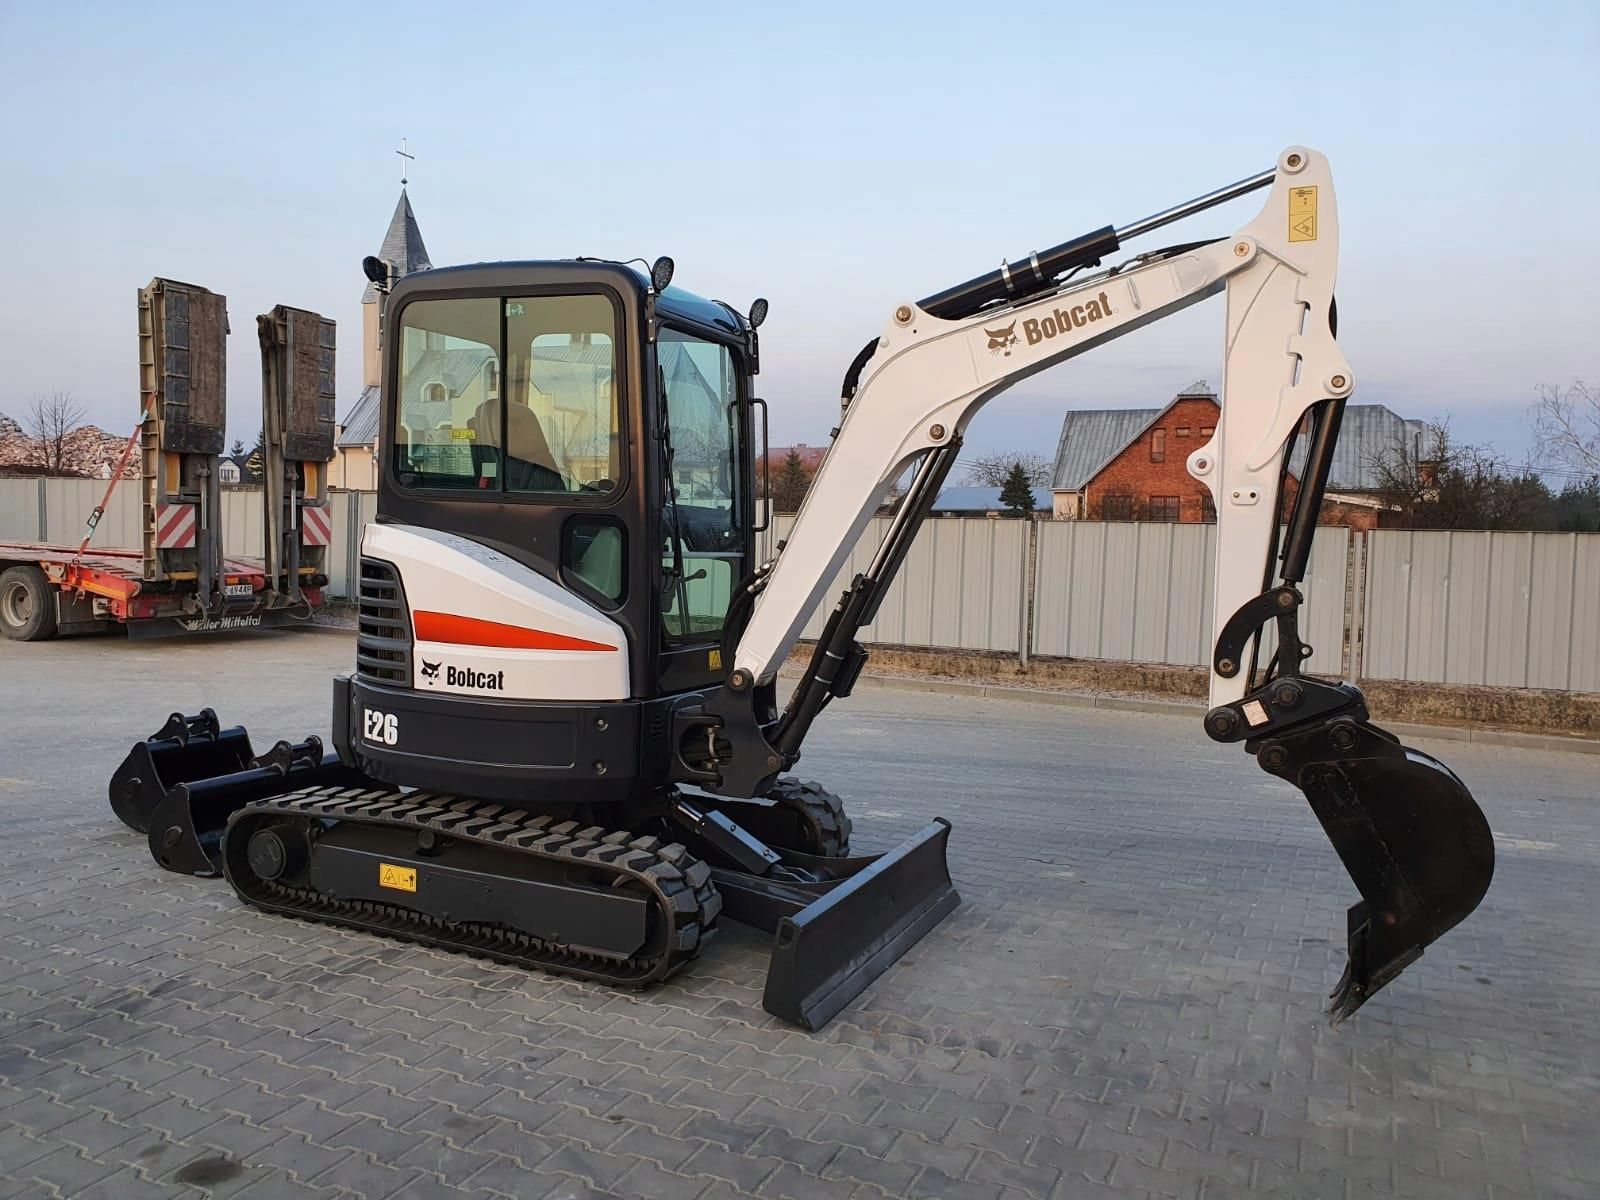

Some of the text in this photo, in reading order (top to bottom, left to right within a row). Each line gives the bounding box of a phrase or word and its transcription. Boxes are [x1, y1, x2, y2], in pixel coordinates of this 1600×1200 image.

[1023, 292, 1113, 345] Bobcat
[221, 615, 262, 629] Mitteltal
[447, 667, 504, 690] Bobcat
[364, 709, 398, 745] E26
